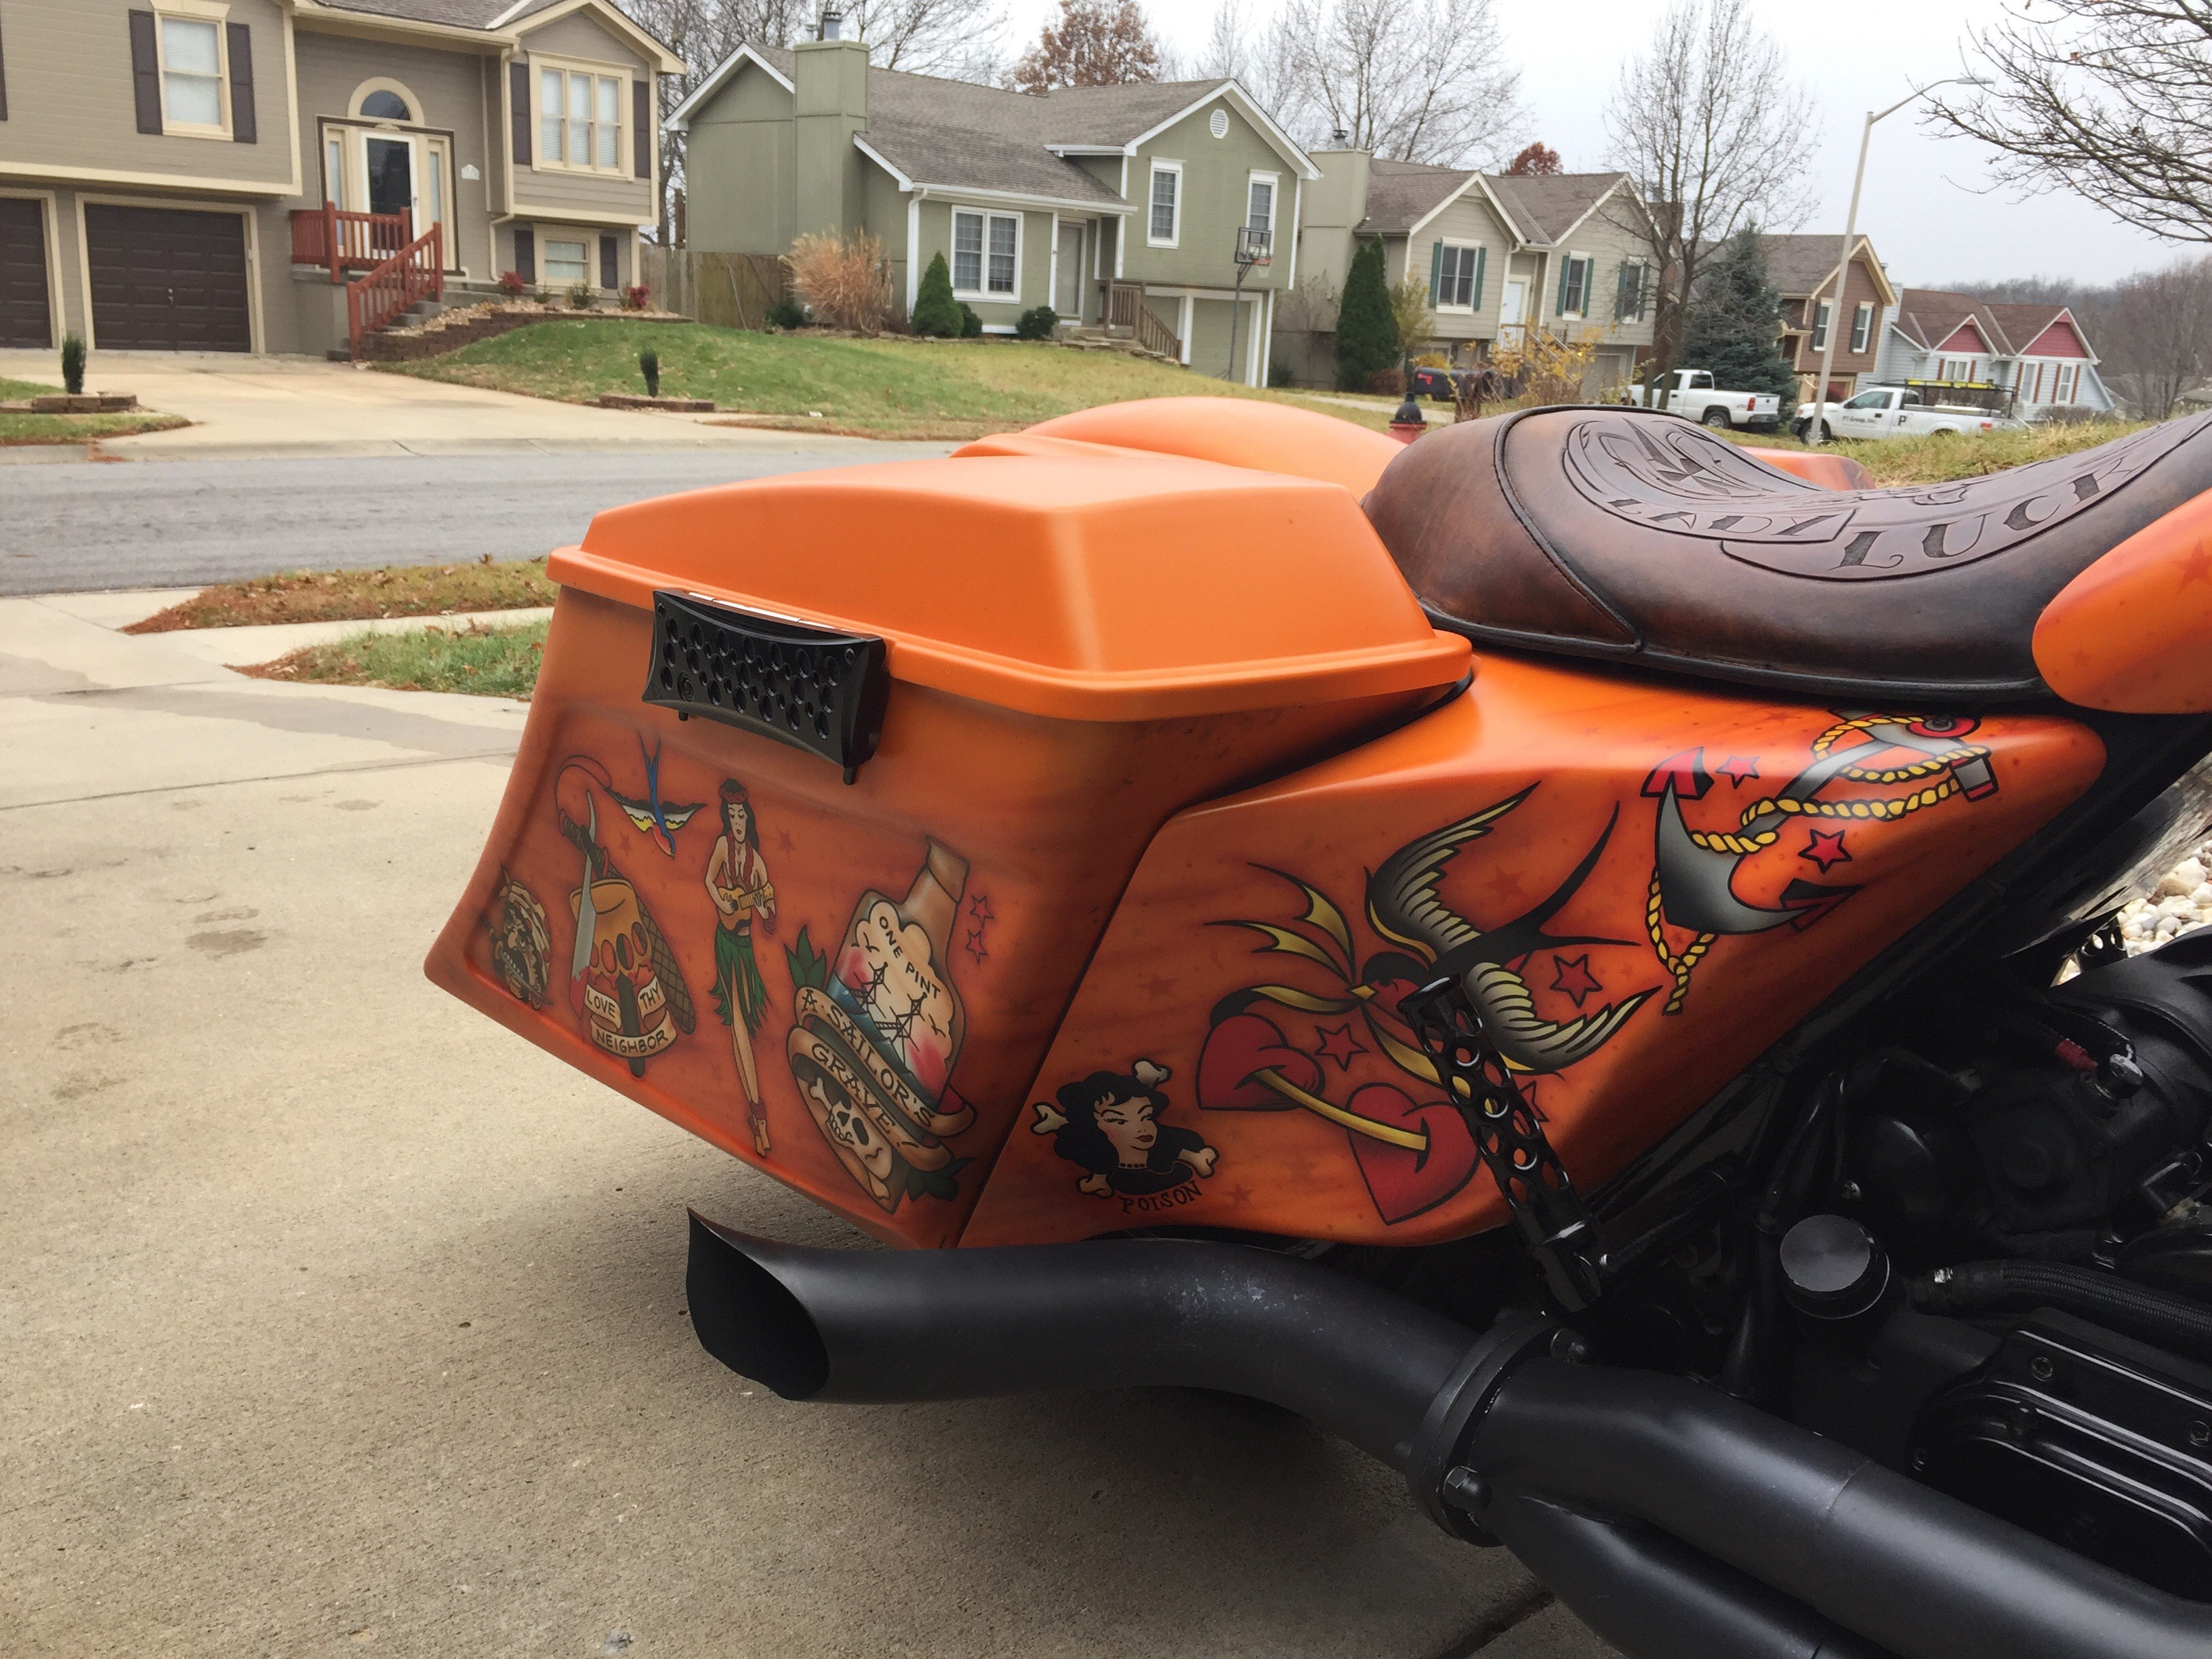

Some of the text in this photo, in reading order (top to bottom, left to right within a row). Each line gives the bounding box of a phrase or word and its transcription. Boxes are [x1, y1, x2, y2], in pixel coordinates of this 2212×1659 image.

[1607, 451, 2145, 571] LADY LUCK
[879, 916, 941, 1000] ONE PINT
[587, 981, 661, 1019] LOVE THY
[596, 1029, 668, 1053] NEIGHBOR
[827, 1006, 935, 1128] SAILOR'S
[1118, 1180, 1202, 1214] POISON
